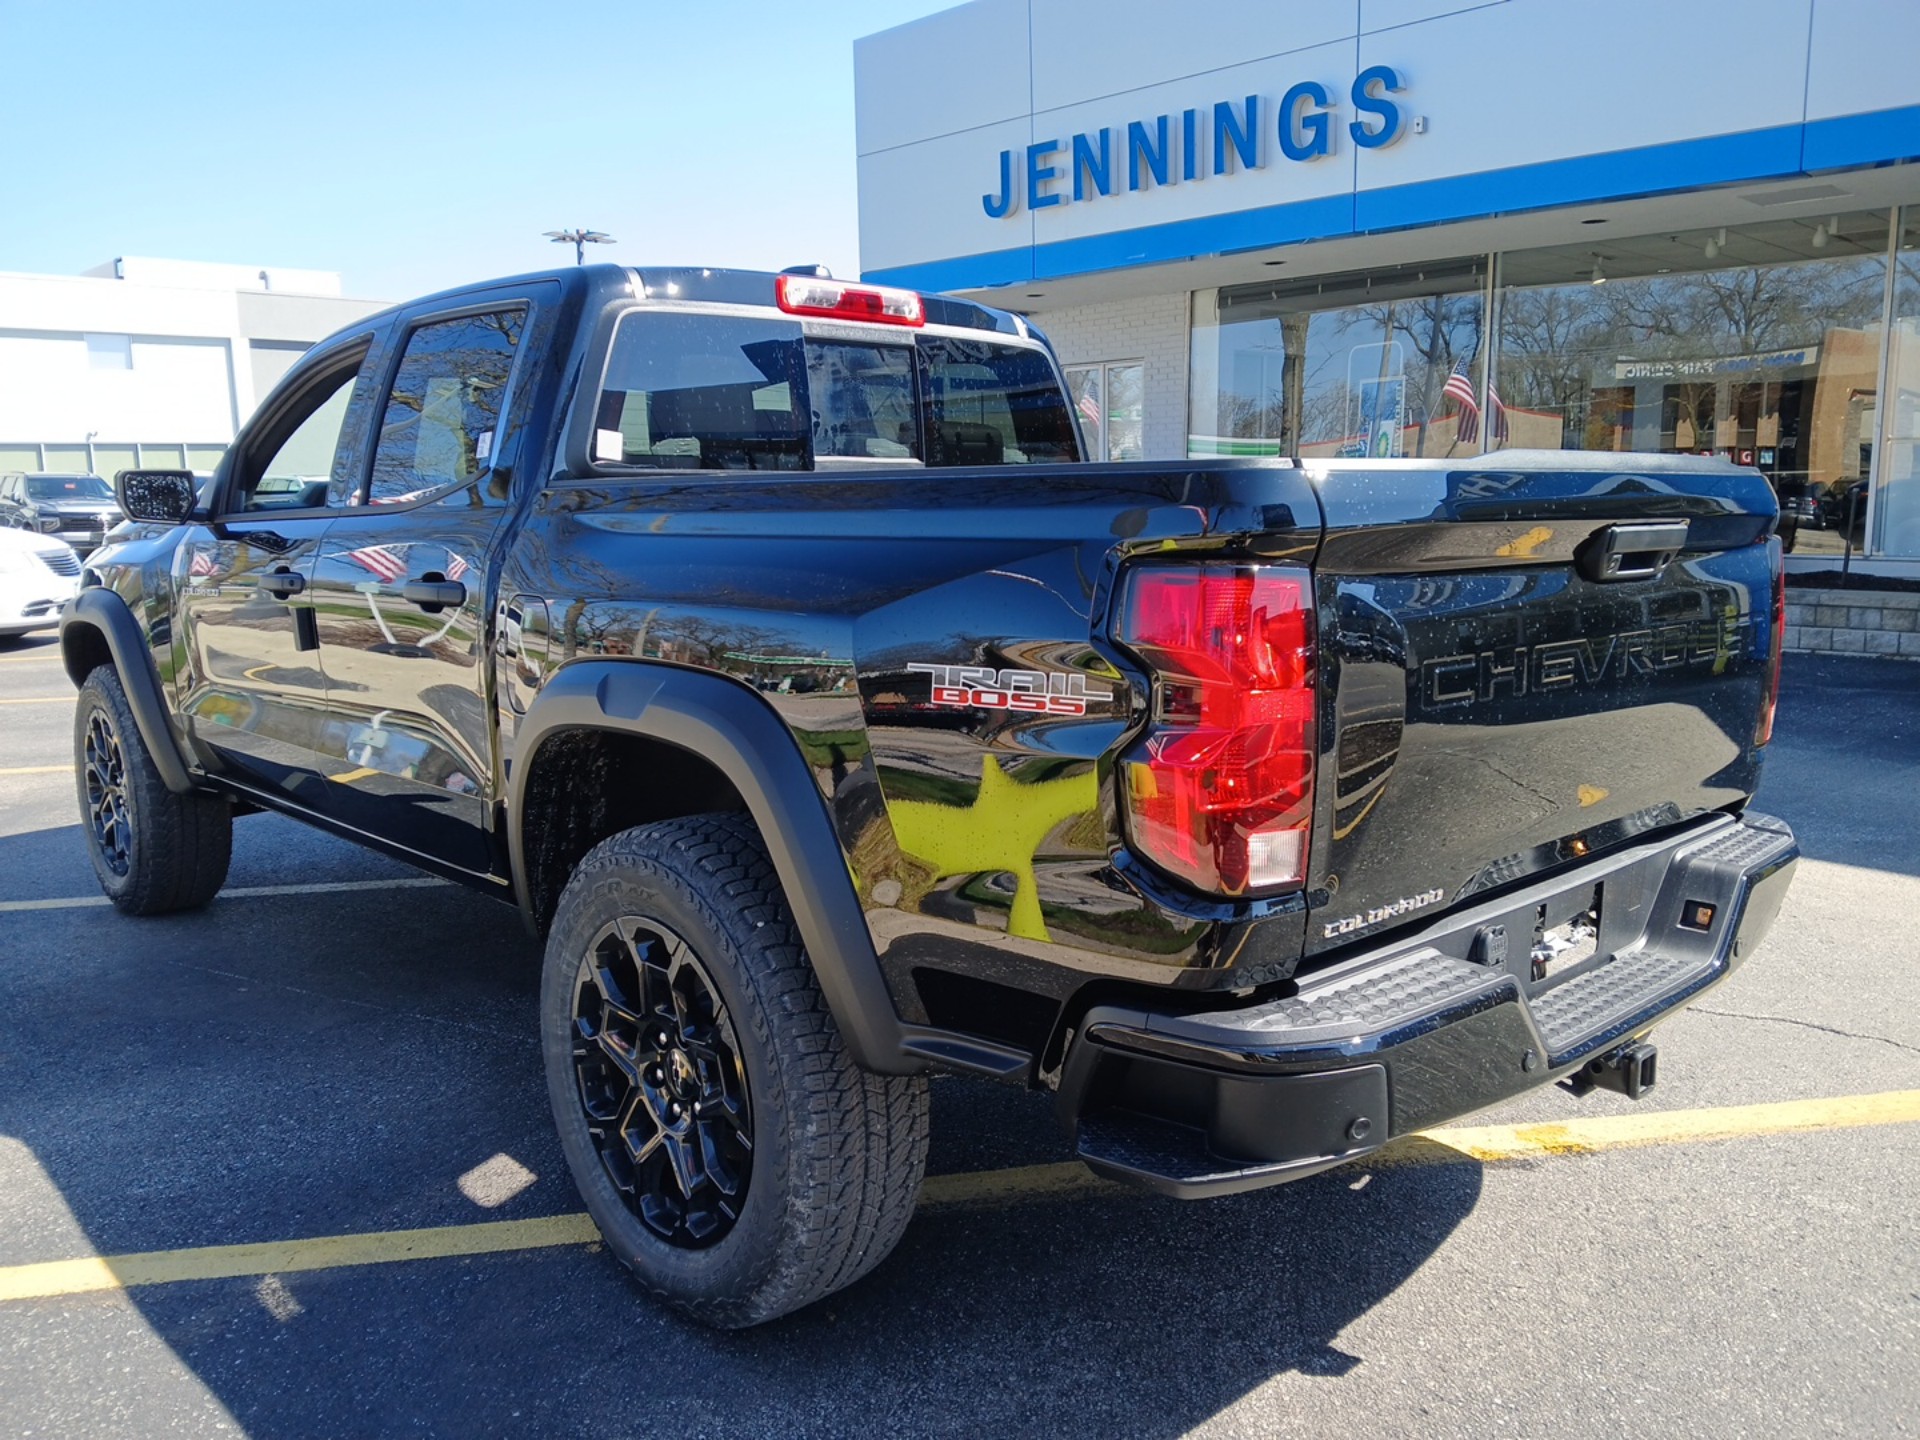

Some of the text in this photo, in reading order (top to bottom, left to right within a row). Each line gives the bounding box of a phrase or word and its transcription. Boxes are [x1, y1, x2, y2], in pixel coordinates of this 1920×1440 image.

[982, 65, 1404, 219] JENNINGS
[907, 662, 1113, 701] TRAIL
[932, 686, 1086, 716] BOSS
[1324, 888, 1444, 938] COLORADO
